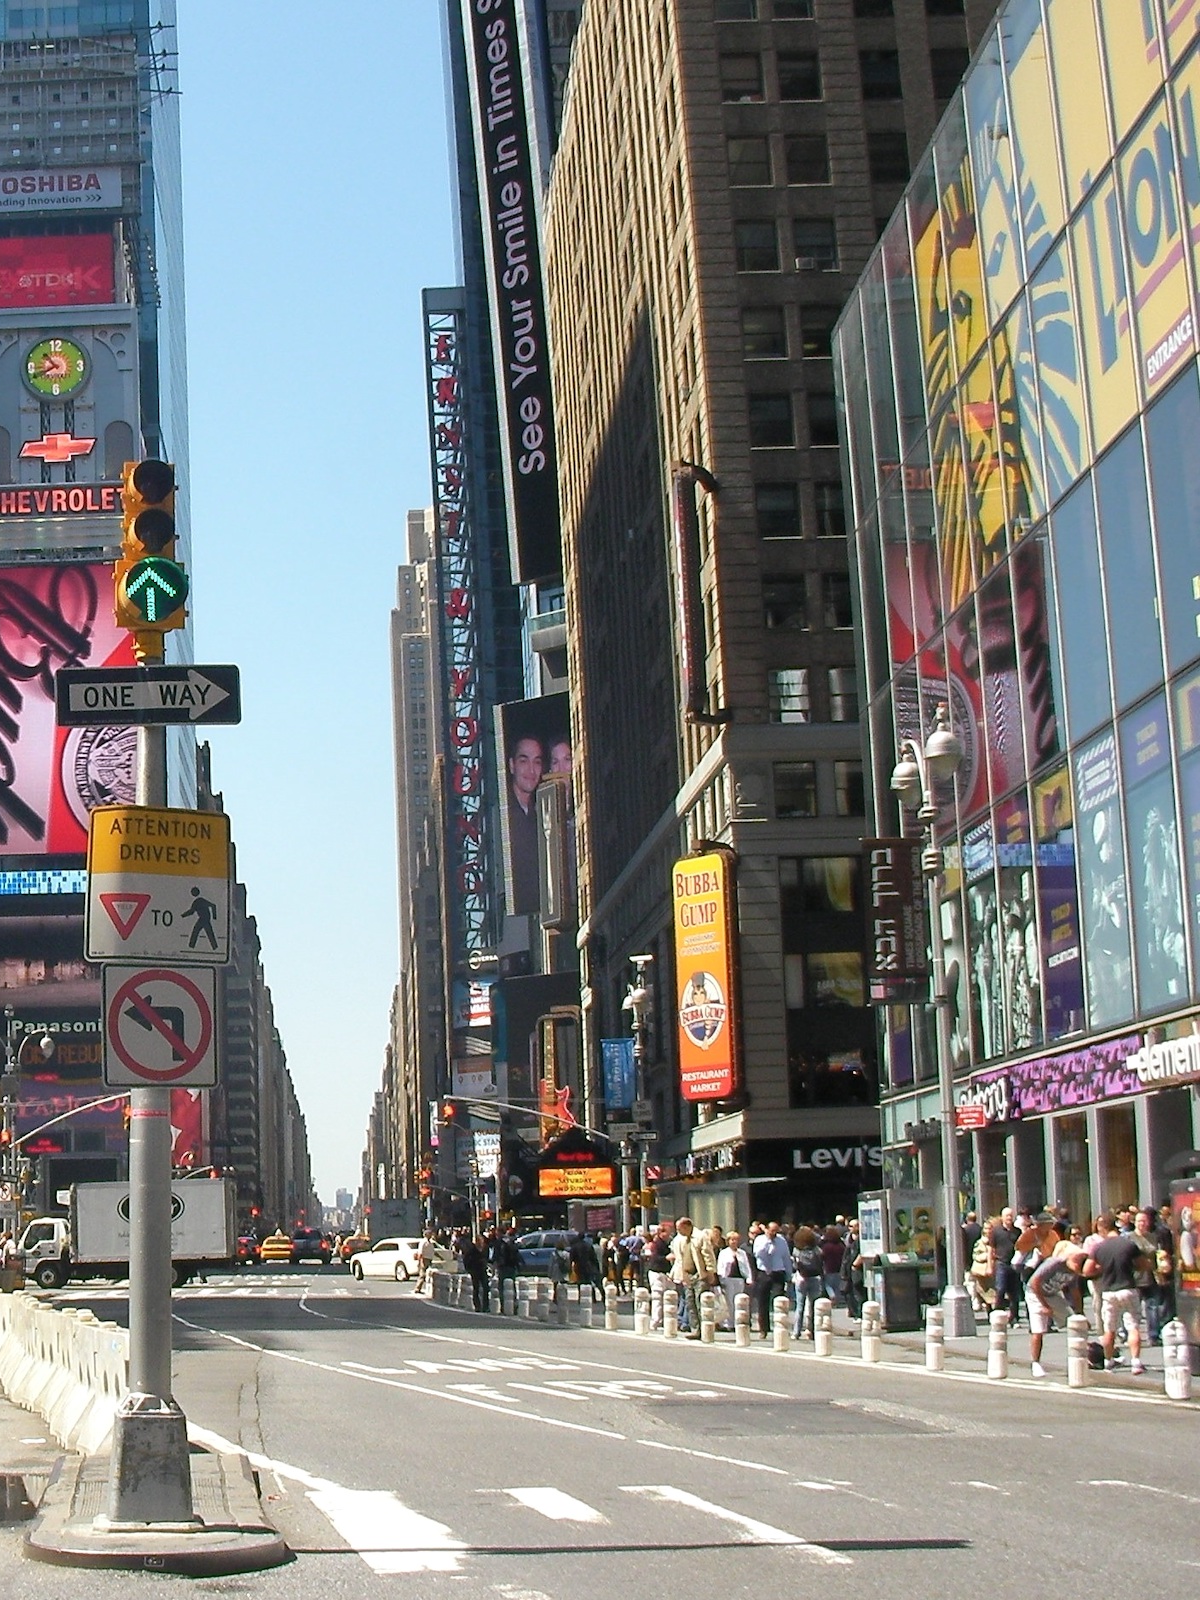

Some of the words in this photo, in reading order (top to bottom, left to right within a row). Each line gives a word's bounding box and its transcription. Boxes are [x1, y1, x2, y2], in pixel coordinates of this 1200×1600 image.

[485, 19, 513, 132] Times
[493, 135, 518, 176] in
[28, 195, 82, 205] Innovation
[498, 180, 529, 289] Smile
[50, 340, 62, 352] 12
[511, 299, 538, 389] Your
[1147, 314, 1194, 379] ENTRANCE
[77, 360, 84, 371] 3
[52, 384, 60, 395] 6
[518, 395, 545, 475] See
[84, 686, 135, 708] ONE
[159, 684, 212, 706] WAY
[110, 818, 212, 840] ATTENTION
[120, 844, 200, 865] DRIVERS
[676, 870, 720, 898] BUBBA
[151, 910, 174, 927] TO
[680, 901, 718, 928] GUMP
[11, 1018, 103, 1034] Panasoni
[681, 1069, 730, 1082] RESTAURANT
[690, 1082, 722, 1093] MARKET
